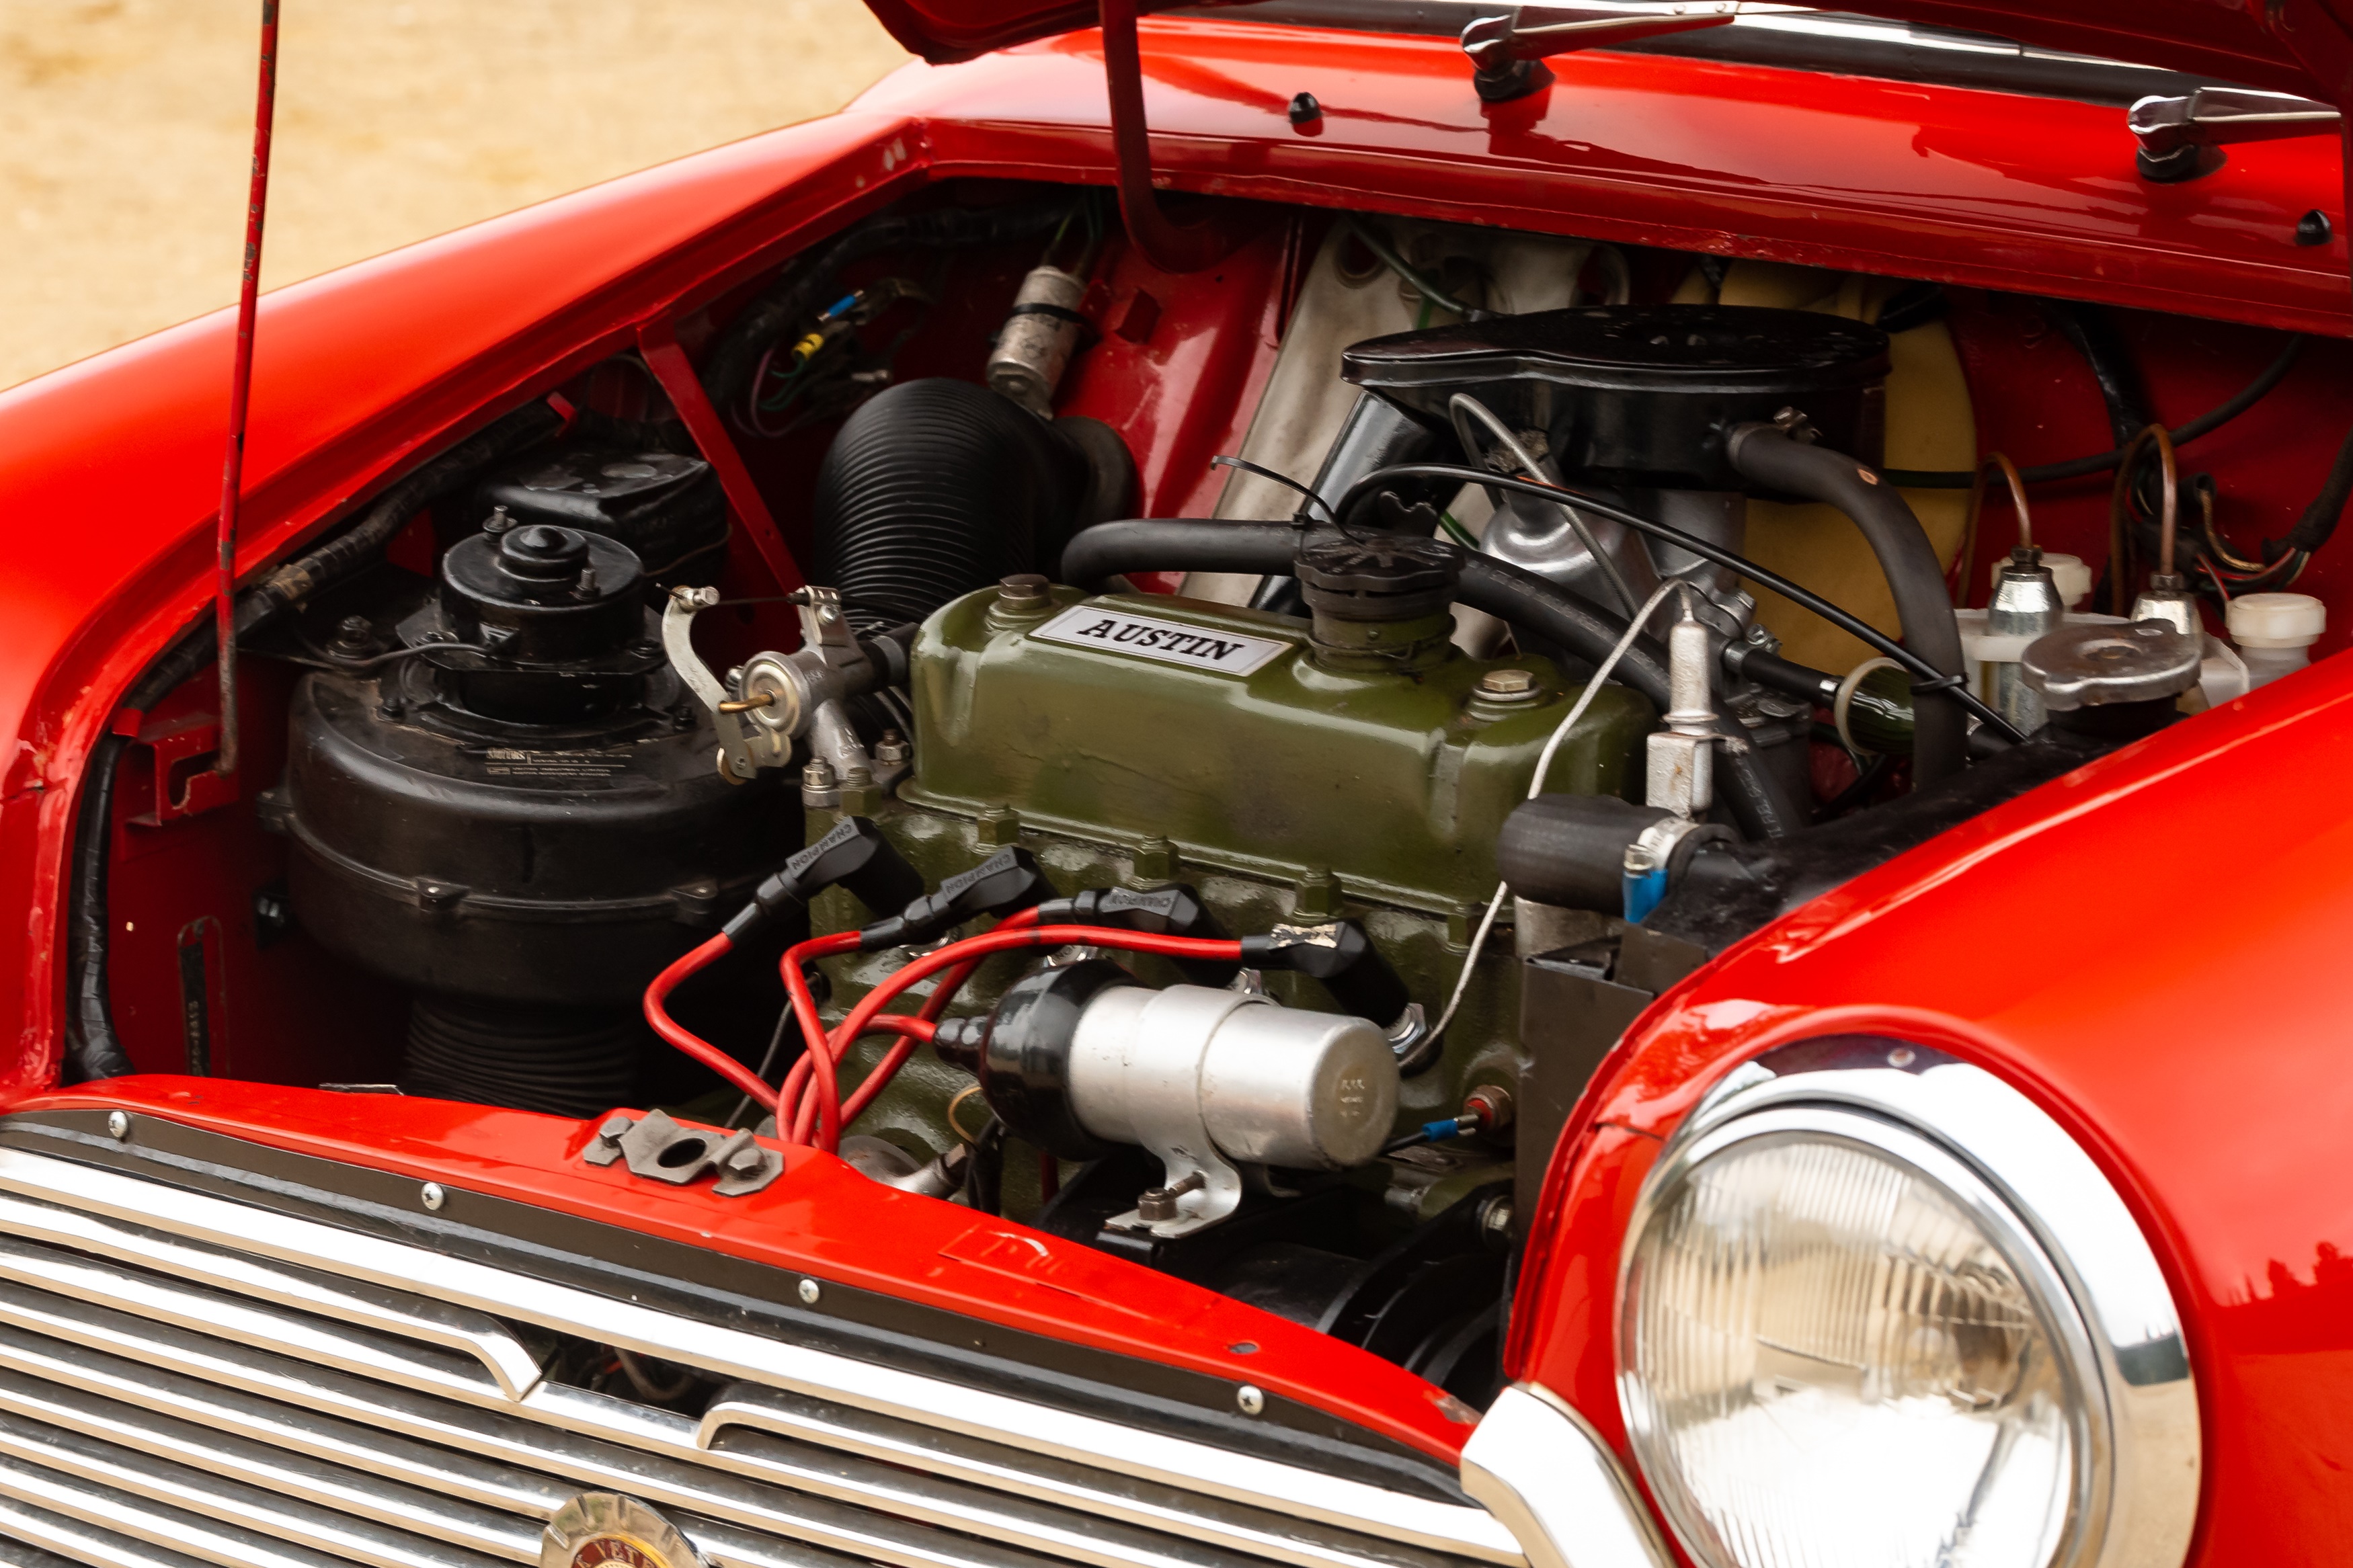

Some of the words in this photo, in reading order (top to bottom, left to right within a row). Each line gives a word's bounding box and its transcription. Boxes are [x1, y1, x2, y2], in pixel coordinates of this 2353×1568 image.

[1077, 619, 1246, 661] AUSTIN
[791, 823, 852, 870] CHAMPION
[945, 854, 1011, 894] CHAMPION
